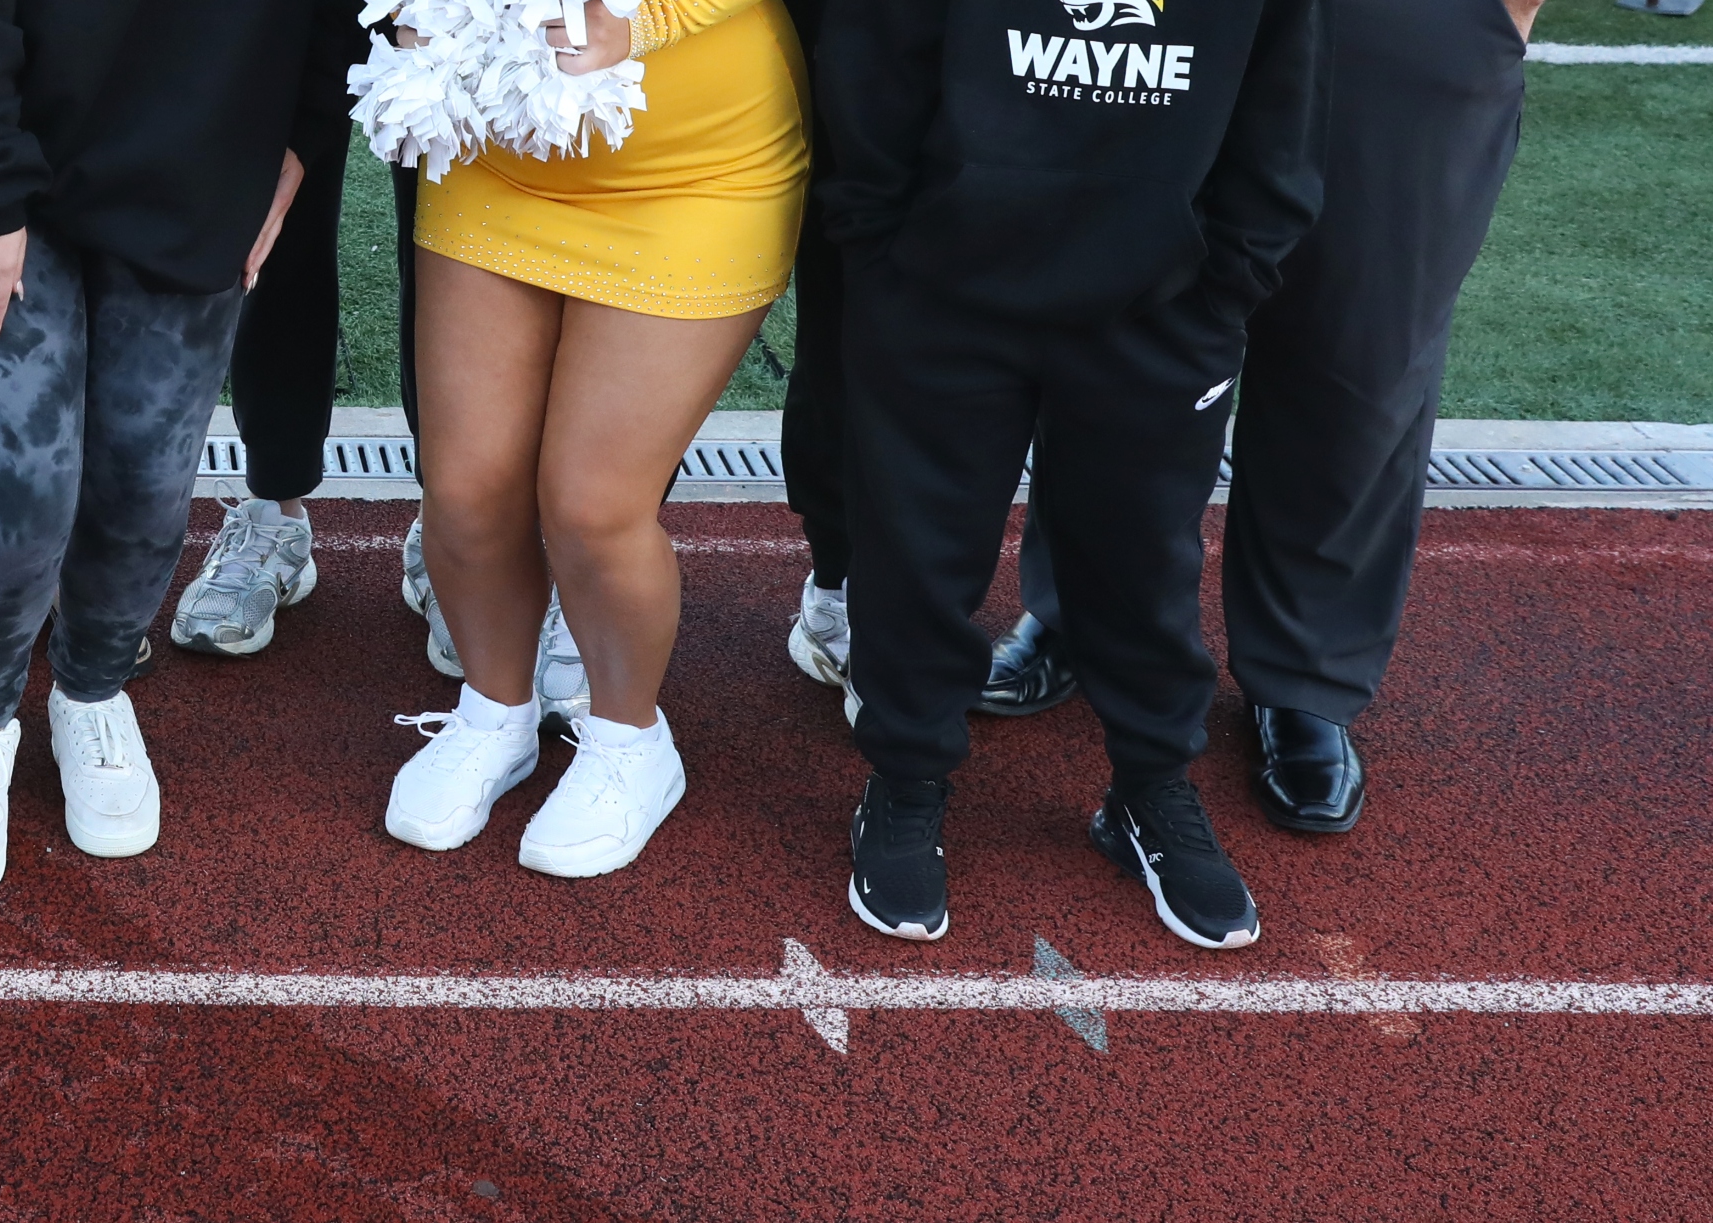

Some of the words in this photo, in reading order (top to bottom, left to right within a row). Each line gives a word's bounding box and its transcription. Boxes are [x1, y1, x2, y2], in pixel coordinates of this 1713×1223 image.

[1007, 28, 1195, 91] WAYNE
[1026, 81, 1083, 101] STATE
[1092, 90, 1172, 106] COLLEGE
